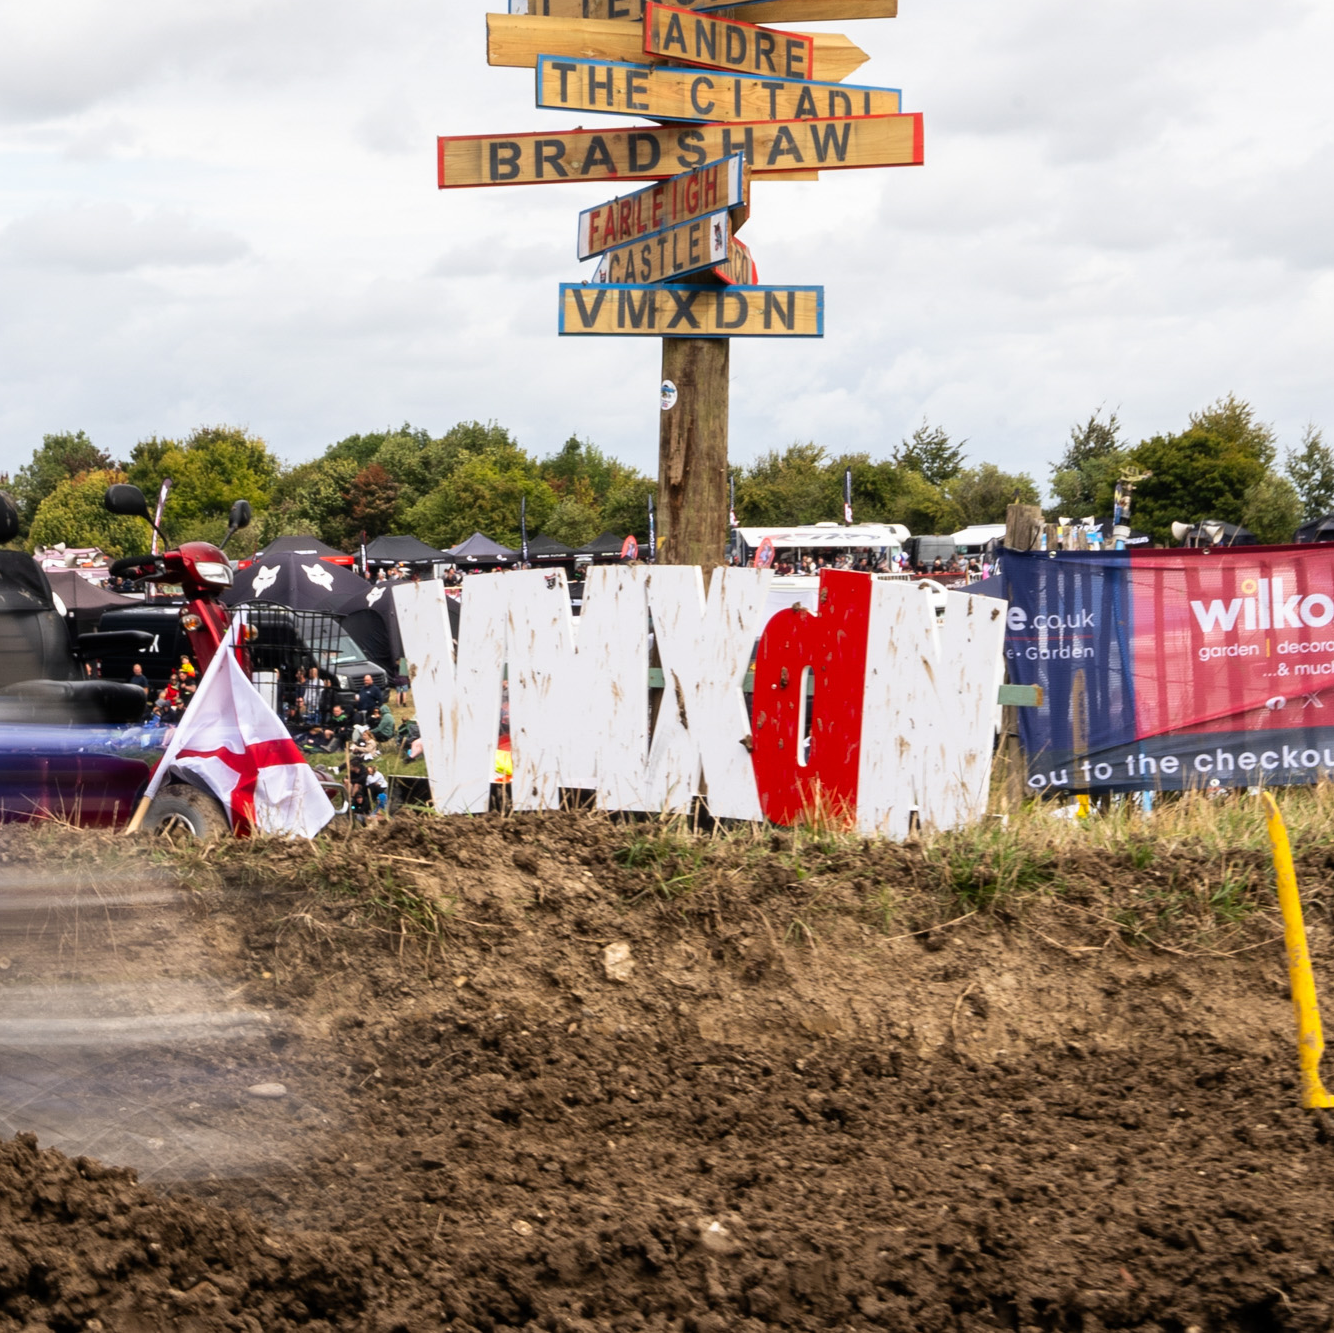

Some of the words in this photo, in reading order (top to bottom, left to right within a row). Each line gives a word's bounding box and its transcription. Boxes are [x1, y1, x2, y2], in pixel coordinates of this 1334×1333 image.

[663, 12, 806, 80] ANDRE
[551, 62, 650, 111] THE
[488, 123, 851, 181] BRADSHAW
[589, 166, 717, 252] FARLEIGH
[609, 223, 701, 284] CASTLE
[571, 289, 796, 329] VMXDN
[1025, 645, 1095, 661] Garden
[1199, 642, 1259, 661] garden
[1080, 760, 1113, 782] to
[1126, 753, 1180, 777] the
